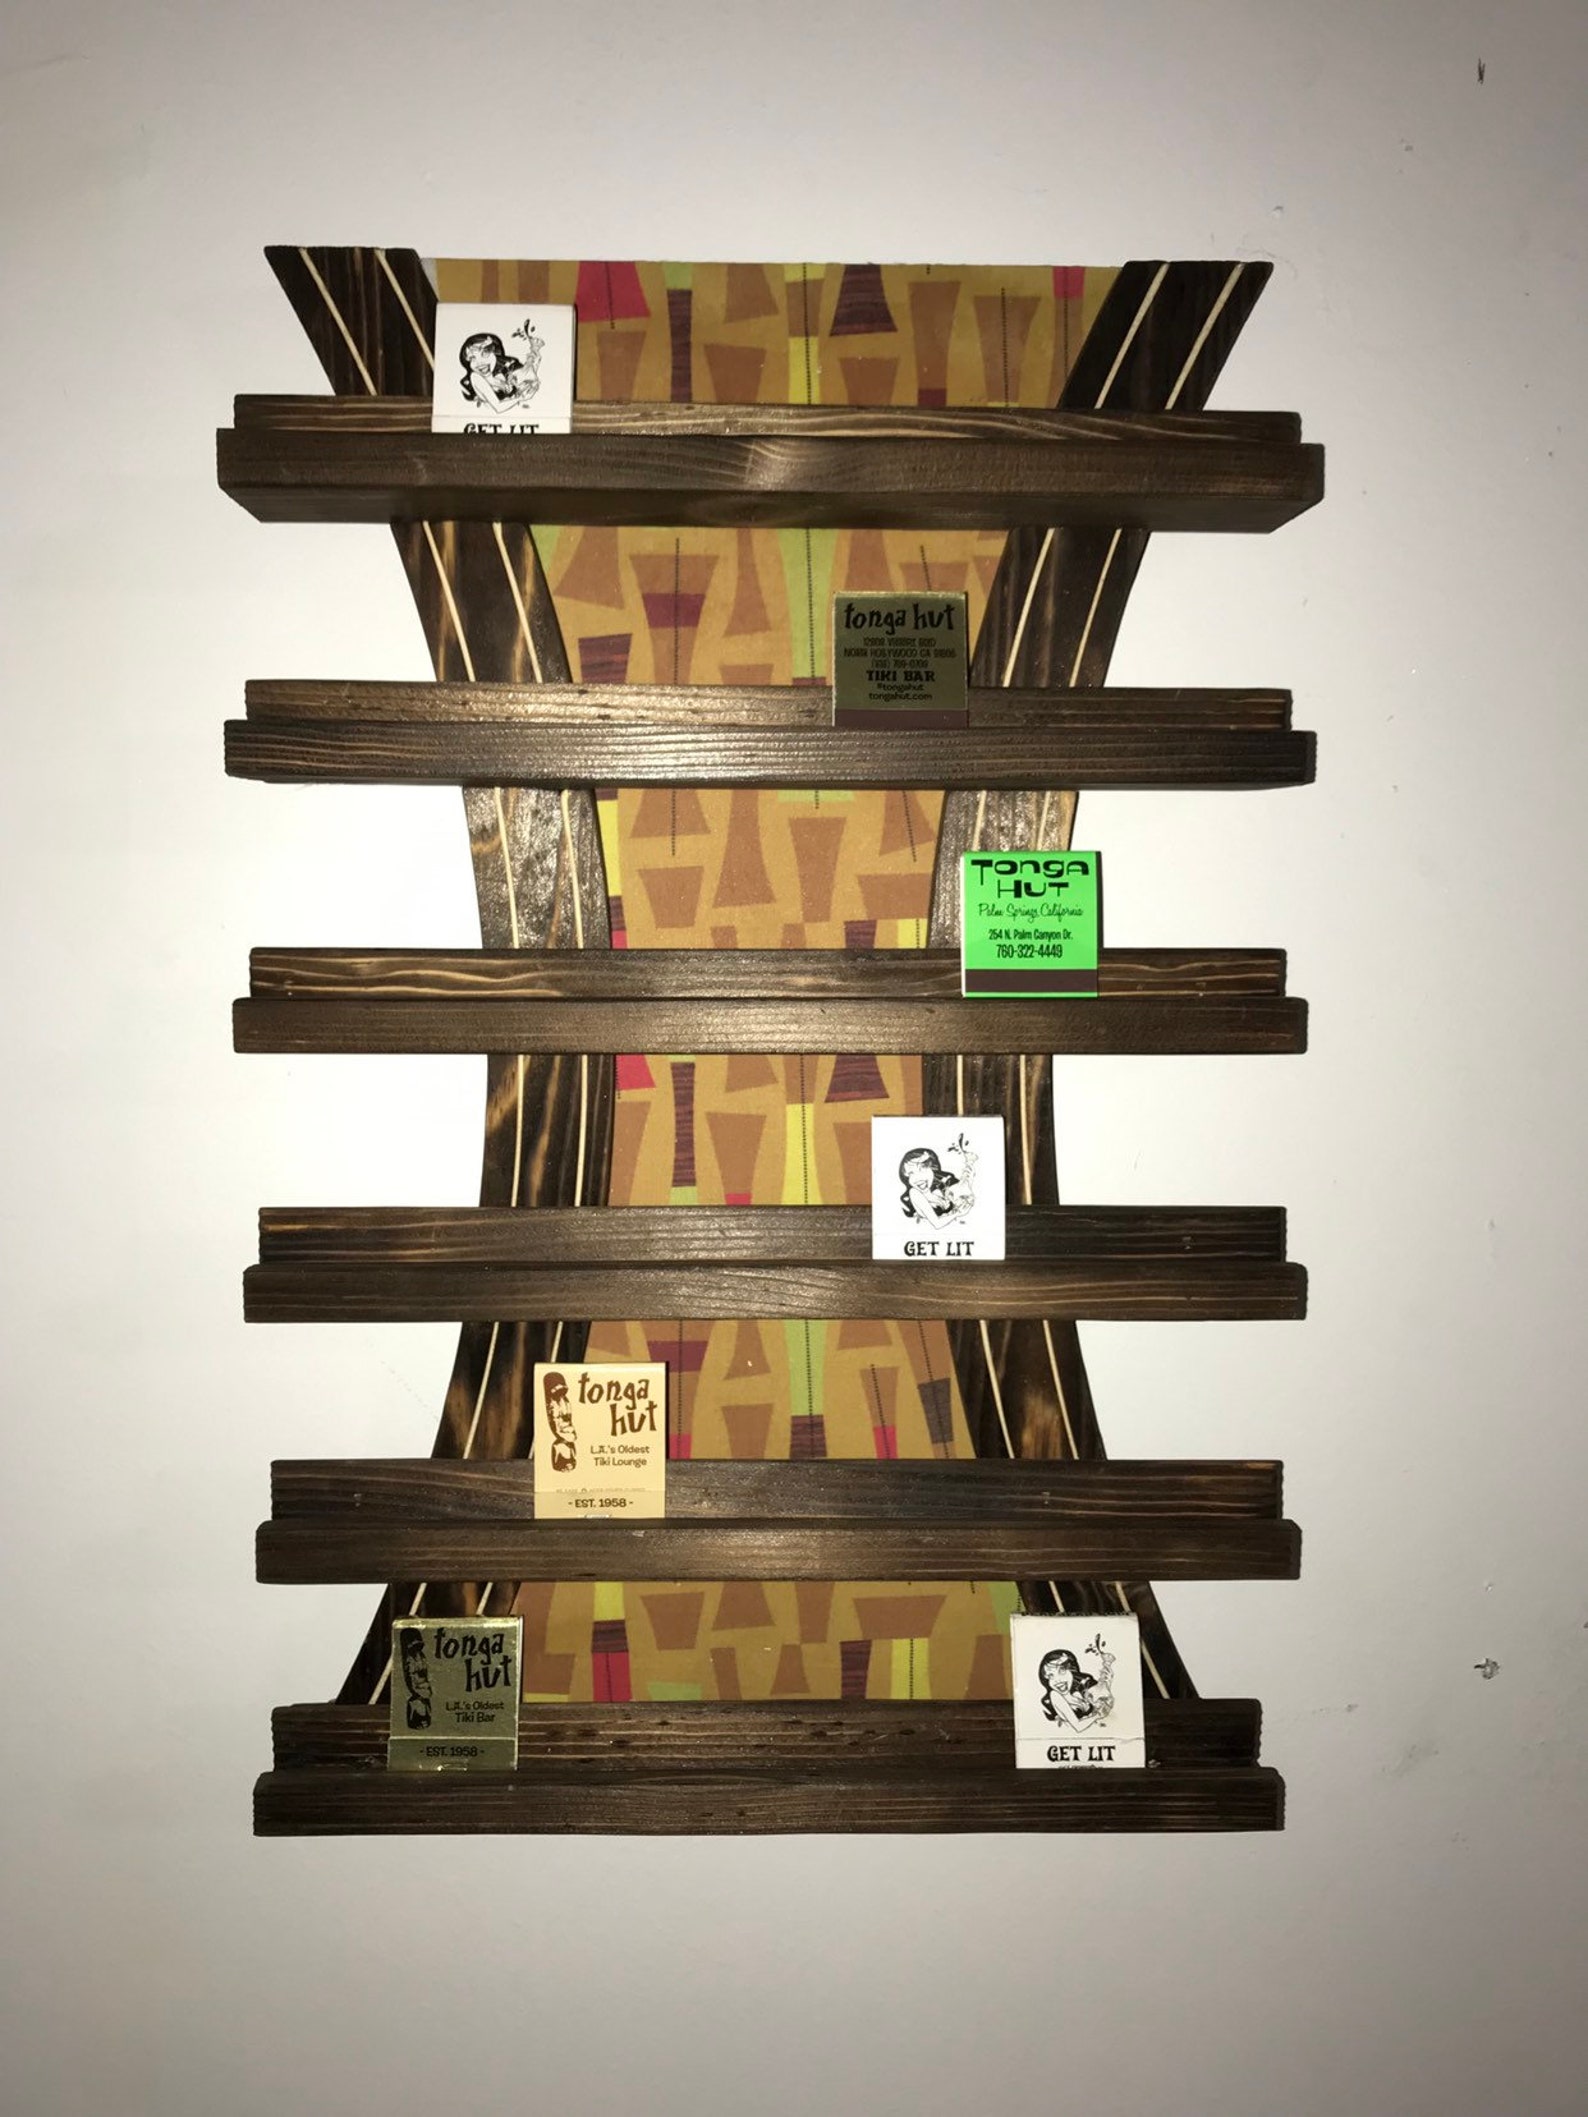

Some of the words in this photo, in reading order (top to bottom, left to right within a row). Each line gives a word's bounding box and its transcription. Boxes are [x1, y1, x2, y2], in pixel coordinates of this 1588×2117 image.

[844, 602, 906, 635] tonga
[913, 602, 956, 630] hut
[866, 670, 897, 682] TIKI
[903, 670, 936, 682] BAR
[997, 879, 1069, 898] HUT
[978, 903, 1003, 916] Palm
[988, 929, 1003, 940] 254
[1013, 929, 1032, 940] Palm
[1033, 929, 1061, 942] Canyon
[904, 1241, 939, 1257] GET
[946, 1241, 974, 1257] LIT
[578, 1372, 650, 1410] tonga
[609, 1400, 658, 1437] hut
[617, 1444, 650, 1454] Oldest
[594, 1457, 610, 1466] Tiki
[612, 1457, 647, 1468] Lounge
[574, 1499, 596, 1508] EST.
[599, 1498, 627, 1508] 1958
[434, 1627, 505, 1666] tonga
[464, 1655, 512, 1692] hut
[455, 1711, 474, 1723] Tiki
[476, 1711, 495, 1723] Bar
[426, 1746, 448, 1757] EST.
[450, 1746, 478, 1757] 1958
[1047, 1745, 1082, 1762] GET
[1087, 1745, 1116, 1762] LIT
